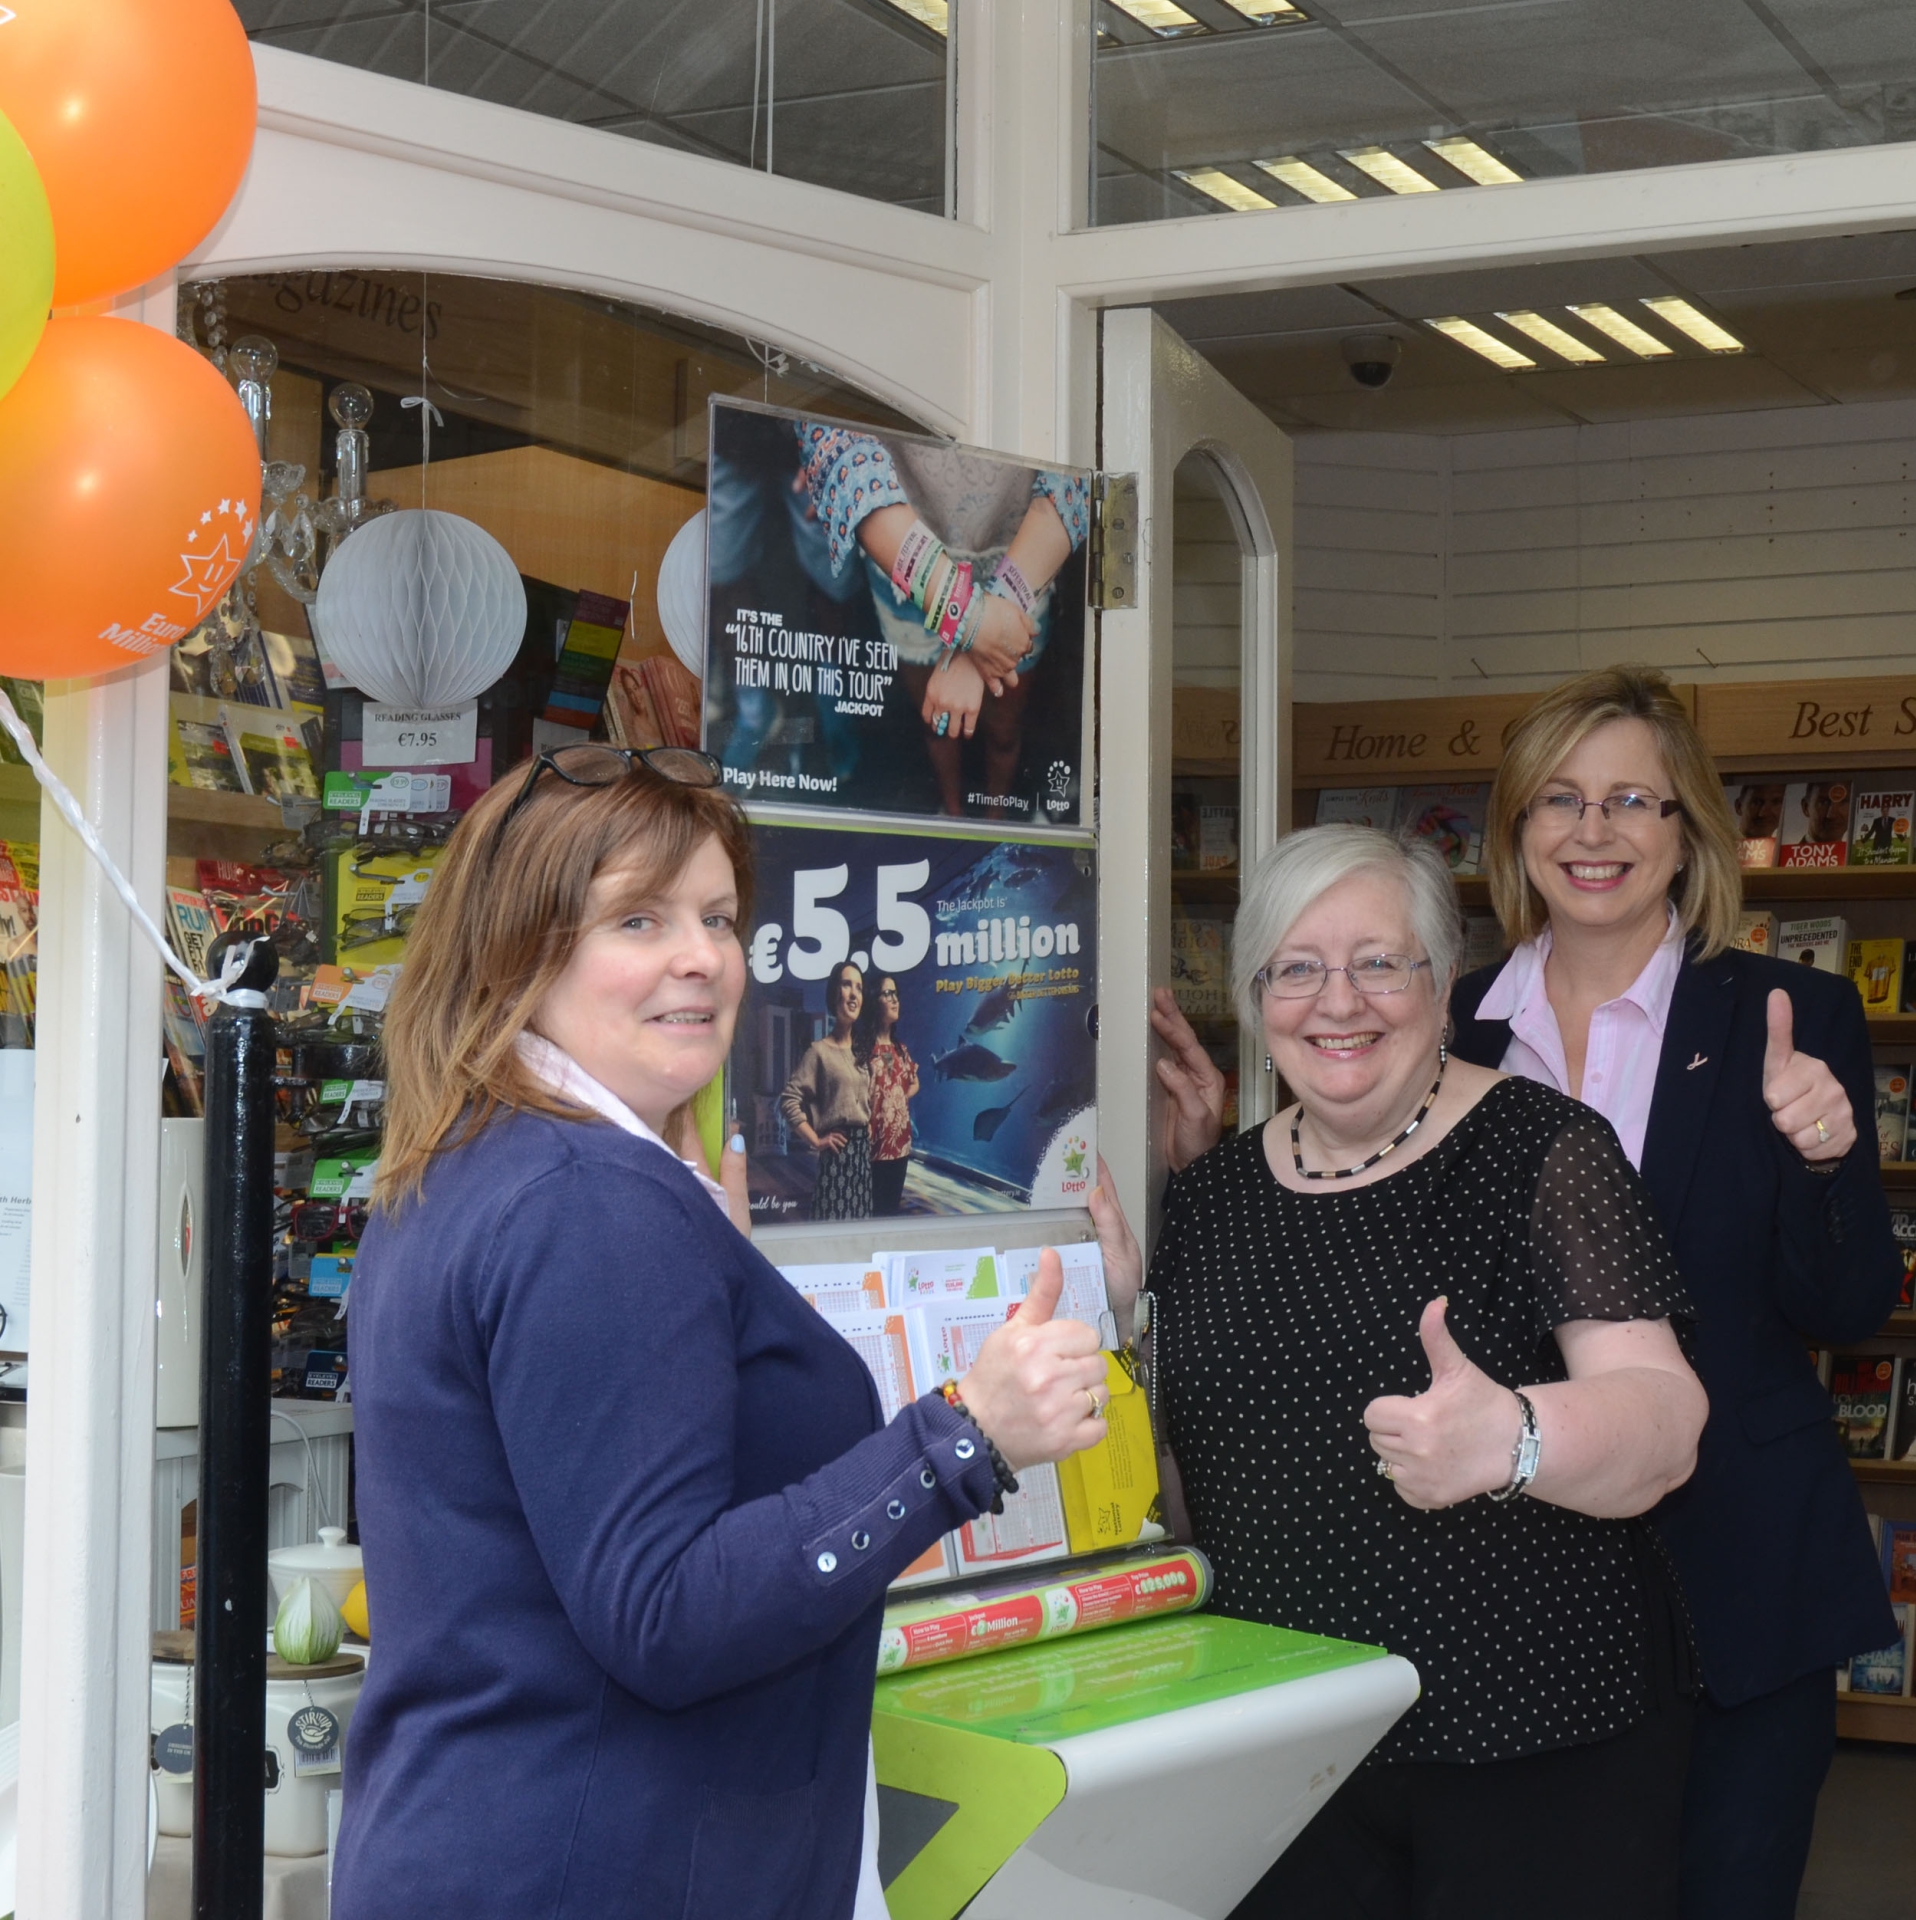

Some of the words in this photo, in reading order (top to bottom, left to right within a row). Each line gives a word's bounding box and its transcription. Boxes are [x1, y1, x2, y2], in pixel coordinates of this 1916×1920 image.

[737, 608, 758, 623] IT'S
[760, 612, 783, 626] THE
[139, 612, 187, 639] Euro
[768, 629, 835, 663] COUNTRY
[838, 636, 861, 667] I'VE
[865, 641, 898, 671] SEEN
[735, 657, 770, 688] THEM
[792, 664, 812, 693] ON
[817, 667, 843, 697] THIS
[834, 700, 884, 717] JACKPOT
[374, 713, 418, 722] READING
[420, 712, 461, 721] GLASSES
[1789, 700, 1874, 739] Best
[398, 732, 437, 747] €7.95
[1325, 722, 1427, 761] Home
[1448, 719, 1481, 757] &
[723, 767, 756, 790] Play
[759, 770, 796, 789] Here
[799, 773, 838, 793] Now!
[967, 792, 1029, 811] #TimeToPlay
[1860, 792, 1913, 810] HARRY
[1791, 844, 1835, 857] TONY
[1785, 855, 1839, 867] ADAMS
[936, 900, 955, 912] The
[956, 898, 994, 913] Jackpot
[997, 897, 1006, 908] is
[1789, 921, 1809, 931] TIGER
[1809, 919, 1832, 930] WOODS
[184, 931, 204, 945] GET
[935, 915, 1080, 967] million
[1780, 930, 1838, 944] UNPRECEDENTED
[1850, 943, 1863, 955] THE
[1849, 955, 1863, 968] END
[936, 979, 963, 994] Play
[966, 976, 1004, 993] Bigger
[1008, 971, 1046, 985] Better
[1048, 967, 1079, 980] Lotto
[314, 991, 340, 999] READERS
[324, 1091, 346, 1100] READERS
[314, 1185, 342, 1194] READERS
[750, 1196, 770, 1210] ould
[771, 1195, 780, 1209] be
[782, 1200, 798, 1213] you
[313, 1285, 341, 1293] READERS
[307, 1379, 336, 1388] READERS
[1838, 1404, 1888, 1418] BLOOD
[968, 1612, 986, 1622] Jackpot
[987, 1616, 1018, 1632] Million
[1854, 1650, 1903, 1666] SHAME
[295, 1711, 321, 1731] STIR
